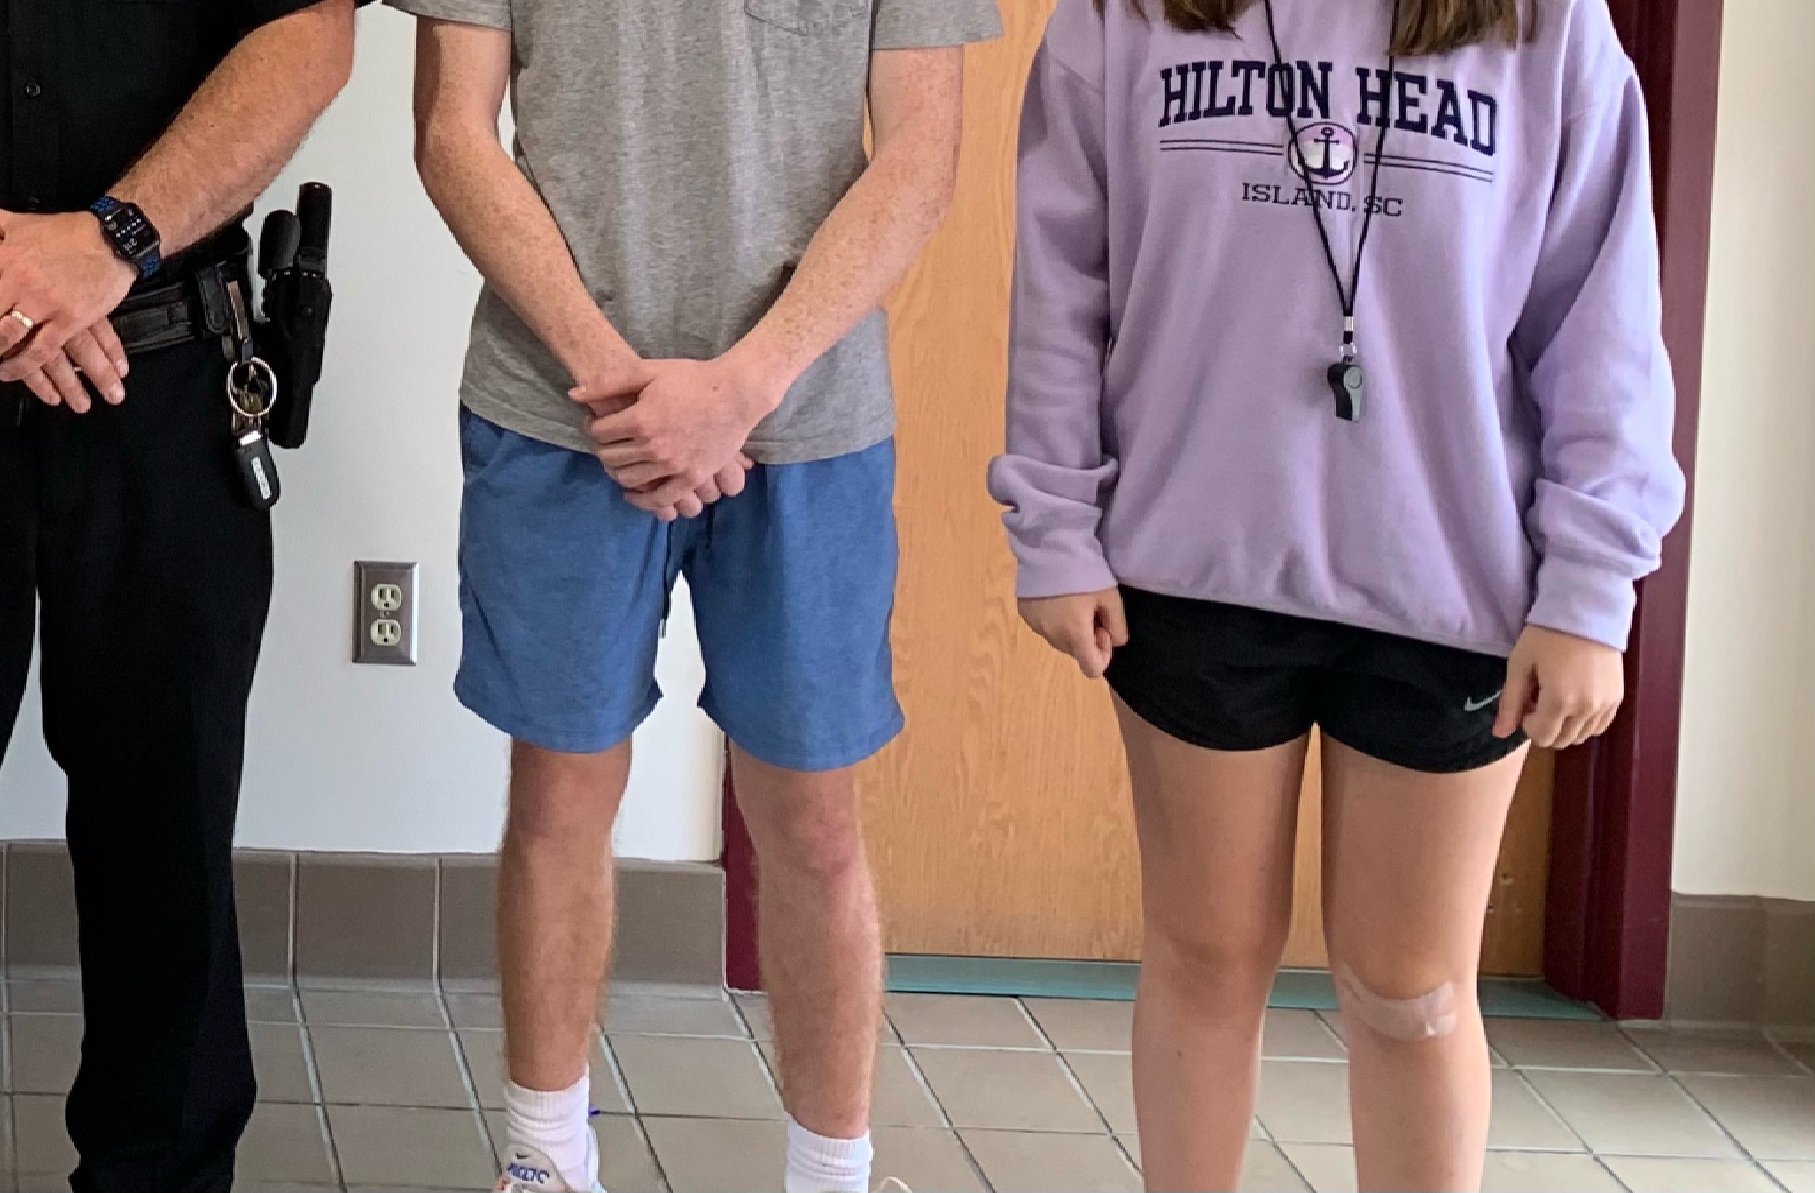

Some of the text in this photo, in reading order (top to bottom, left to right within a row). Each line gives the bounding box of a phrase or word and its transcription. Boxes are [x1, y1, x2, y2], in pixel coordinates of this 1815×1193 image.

[1157, 59, 1499, 157] HILTON HEAD
[1363, 194, 1404, 217] SC
